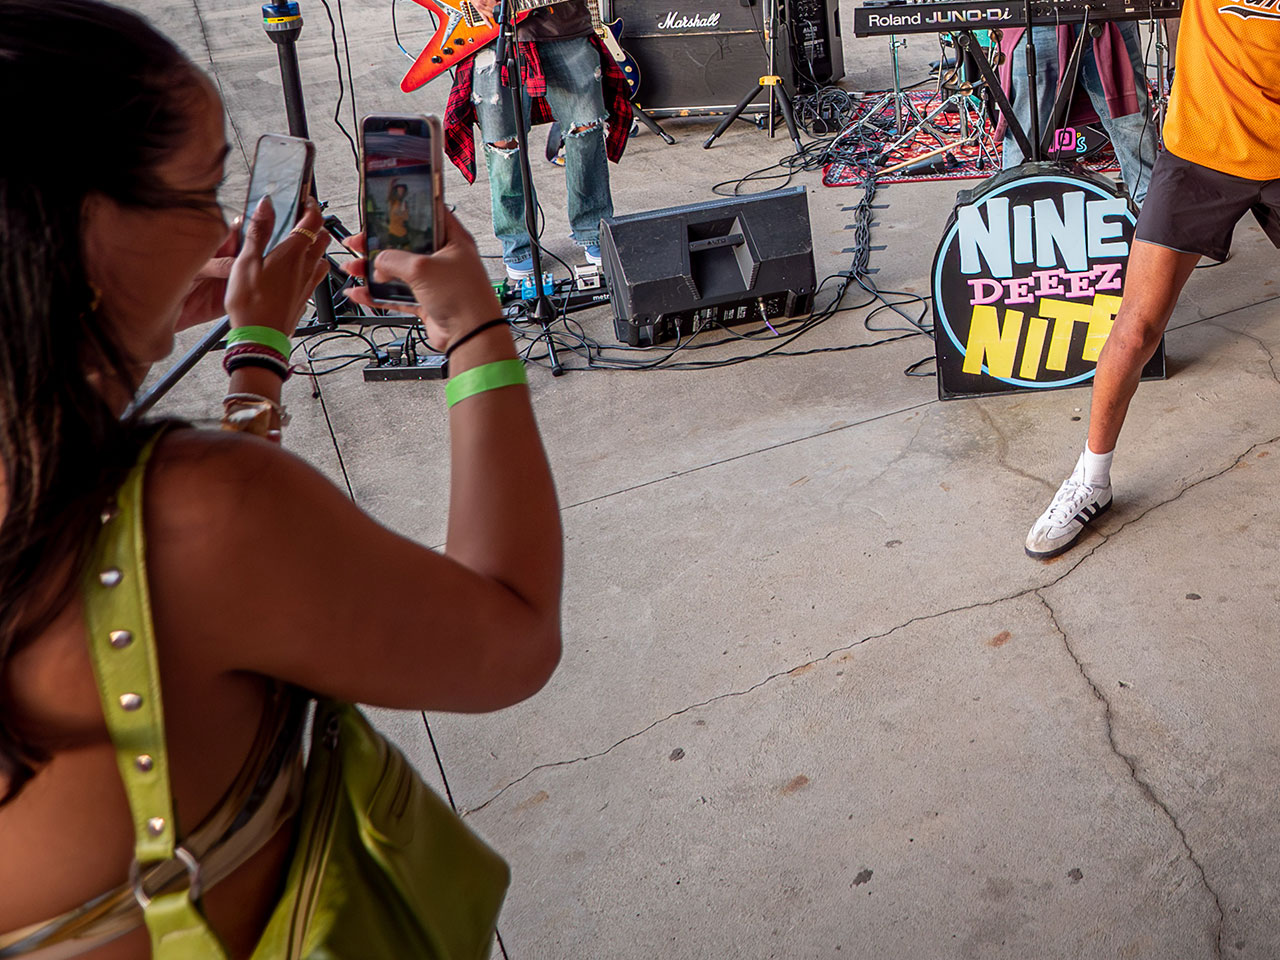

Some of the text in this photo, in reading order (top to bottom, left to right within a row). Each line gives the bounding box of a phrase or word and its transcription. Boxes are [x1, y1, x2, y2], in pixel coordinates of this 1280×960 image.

[658, 11, 721, 29] Marshall
[868, 8, 1012, 27] Roland JUNO-Di
[958, 191, 1129, 278] NINE
[967, 263, 1122, 305] DEEEZ
